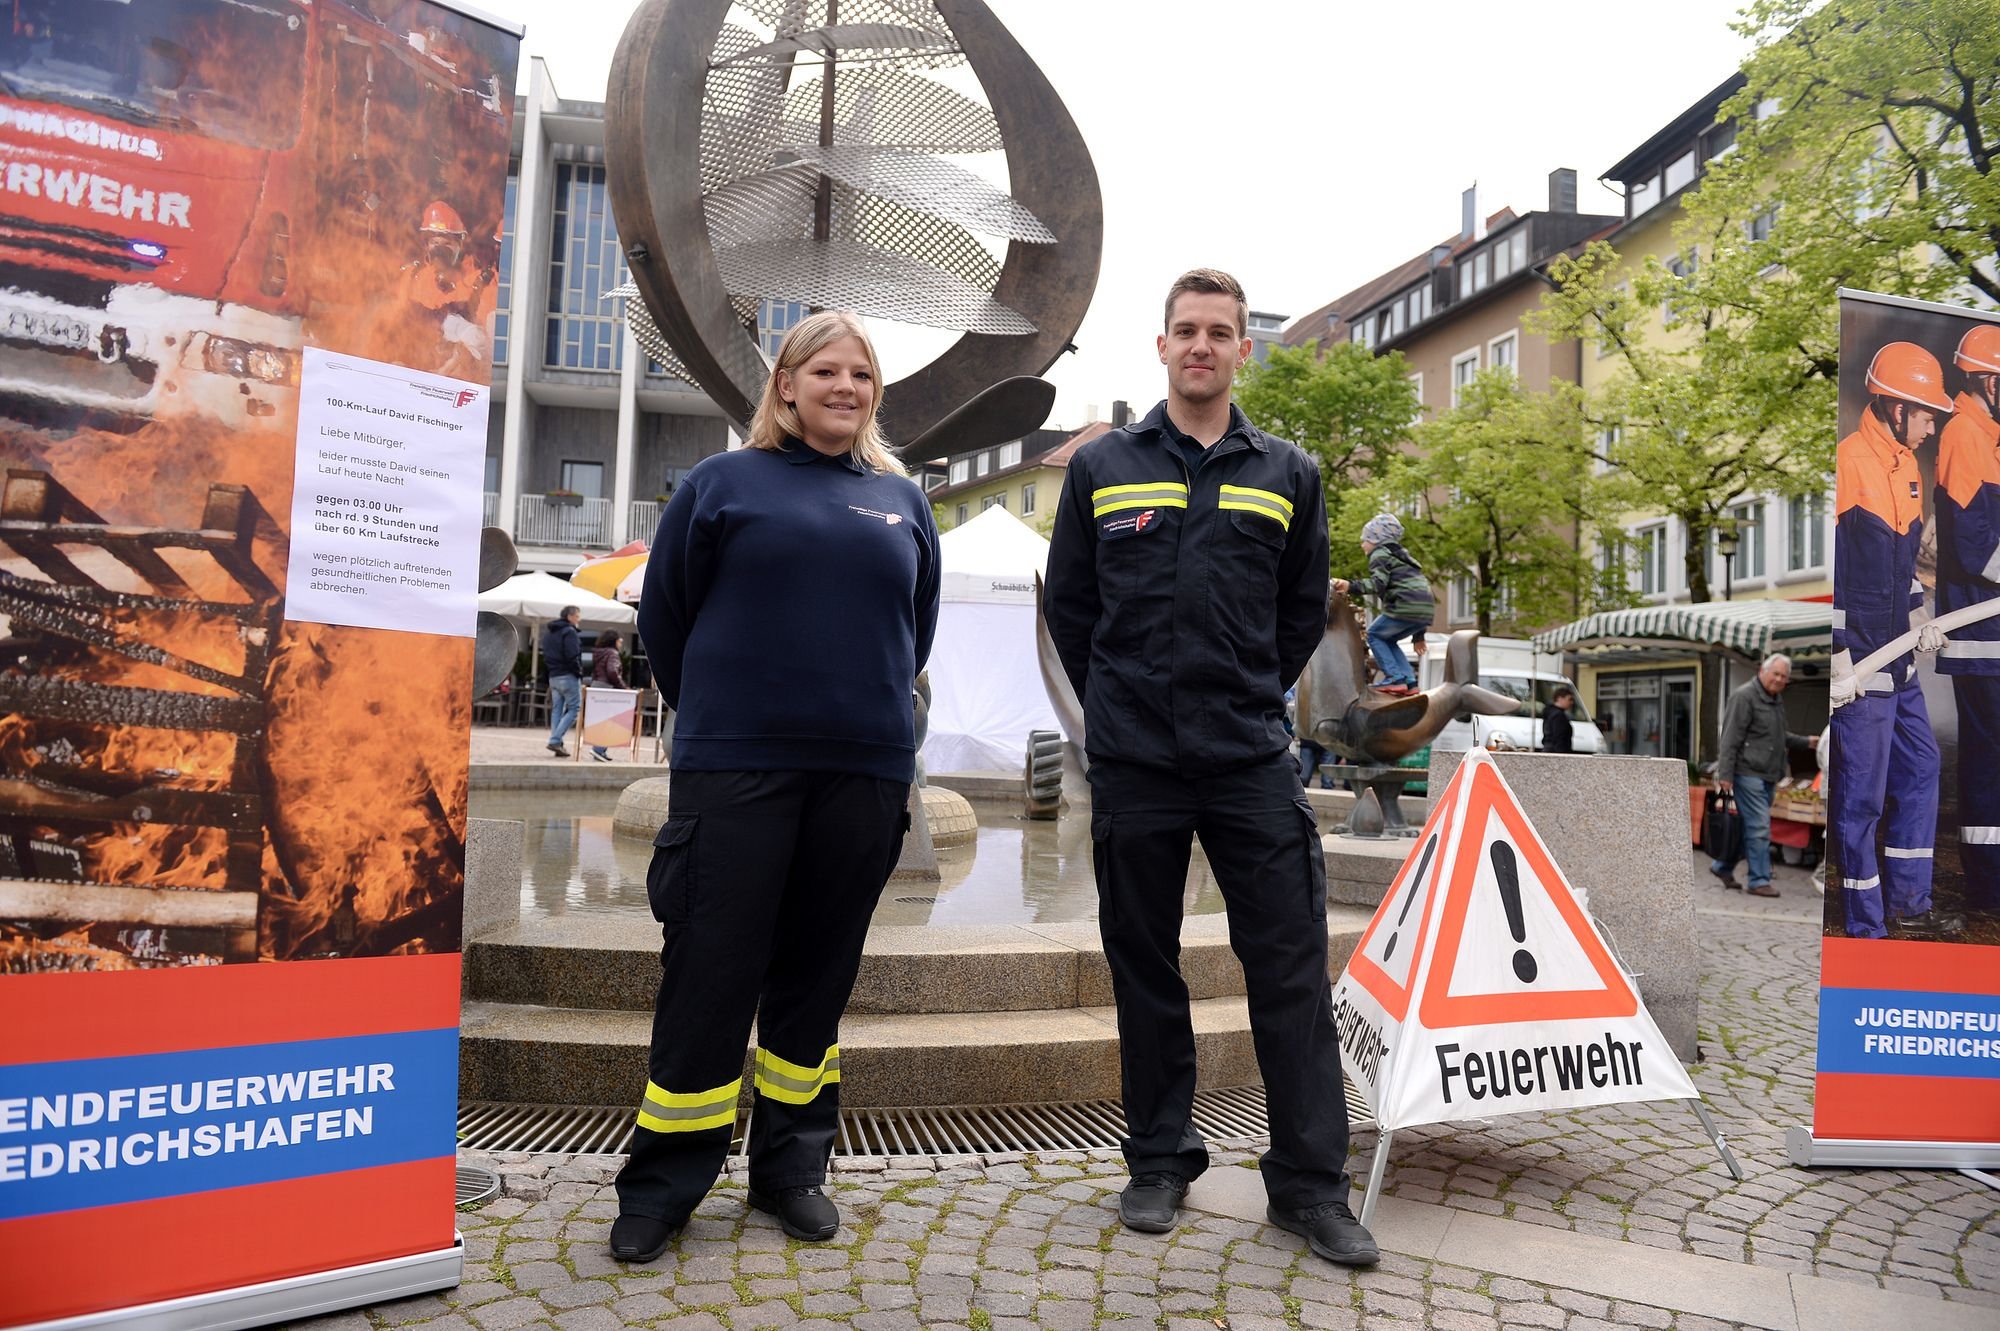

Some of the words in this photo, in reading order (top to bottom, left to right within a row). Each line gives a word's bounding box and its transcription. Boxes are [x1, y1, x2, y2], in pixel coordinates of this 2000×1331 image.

[0, 161, 192, 228] RWEHR
[326, 397, 387, 416] 100-Km-Lauf
[389, 409, 415, 421] David
[417, 415, 463, 431] Fischinger
[320, 425, 351, 439] Liebe
[353, 431, 406, 450] Mitbürger,
[318, 464, 342, 476] Lauf
[344, 467, 373, 481] heute
[375, 473, 404, 486] Nacht
[319, 449, 347, 462] leider
[350, 456, 387, 469] musste
[389, 461, 417, 474] David
[419, 468, 450, 480] seinen
[316, 494, 350, 507] gegen
[353, 498, 381, 511] 03.00
[384, 503, 404, 514] Uhr
[315, 508, 342, 520] nach
[345, 511, 360, 522] rd.
[362, 514, 369, 523] 9
[372, 515, 416, 530] Stunden
[419, 523, 439, 533] und
[314, 522, 340, 533] über
[342, 525, 356, 536] 60
[358, 528, 377, 539] Km
[380, 531, 440, 547] Laufstrecke
[313, 552, 347, 565] wegen
[350, 554, 391, 570] plötzlich
[393, 561, 452, 577] auftretenden
[310, 580, 368, 596] abbrechen.
[311, 566, 397, 584] gesundheitlichen
[400, 576, 450, 591] Problemen
[1854, 1008, 2000, 1032] JUGENDFEU
[1435, 1032, 1643, 1104] Feuerwehr
[0, 1063, 395, 1134] ENDFEUERWEHR
[0, 1106, 373, 1182] EDRICHSHAFEN
